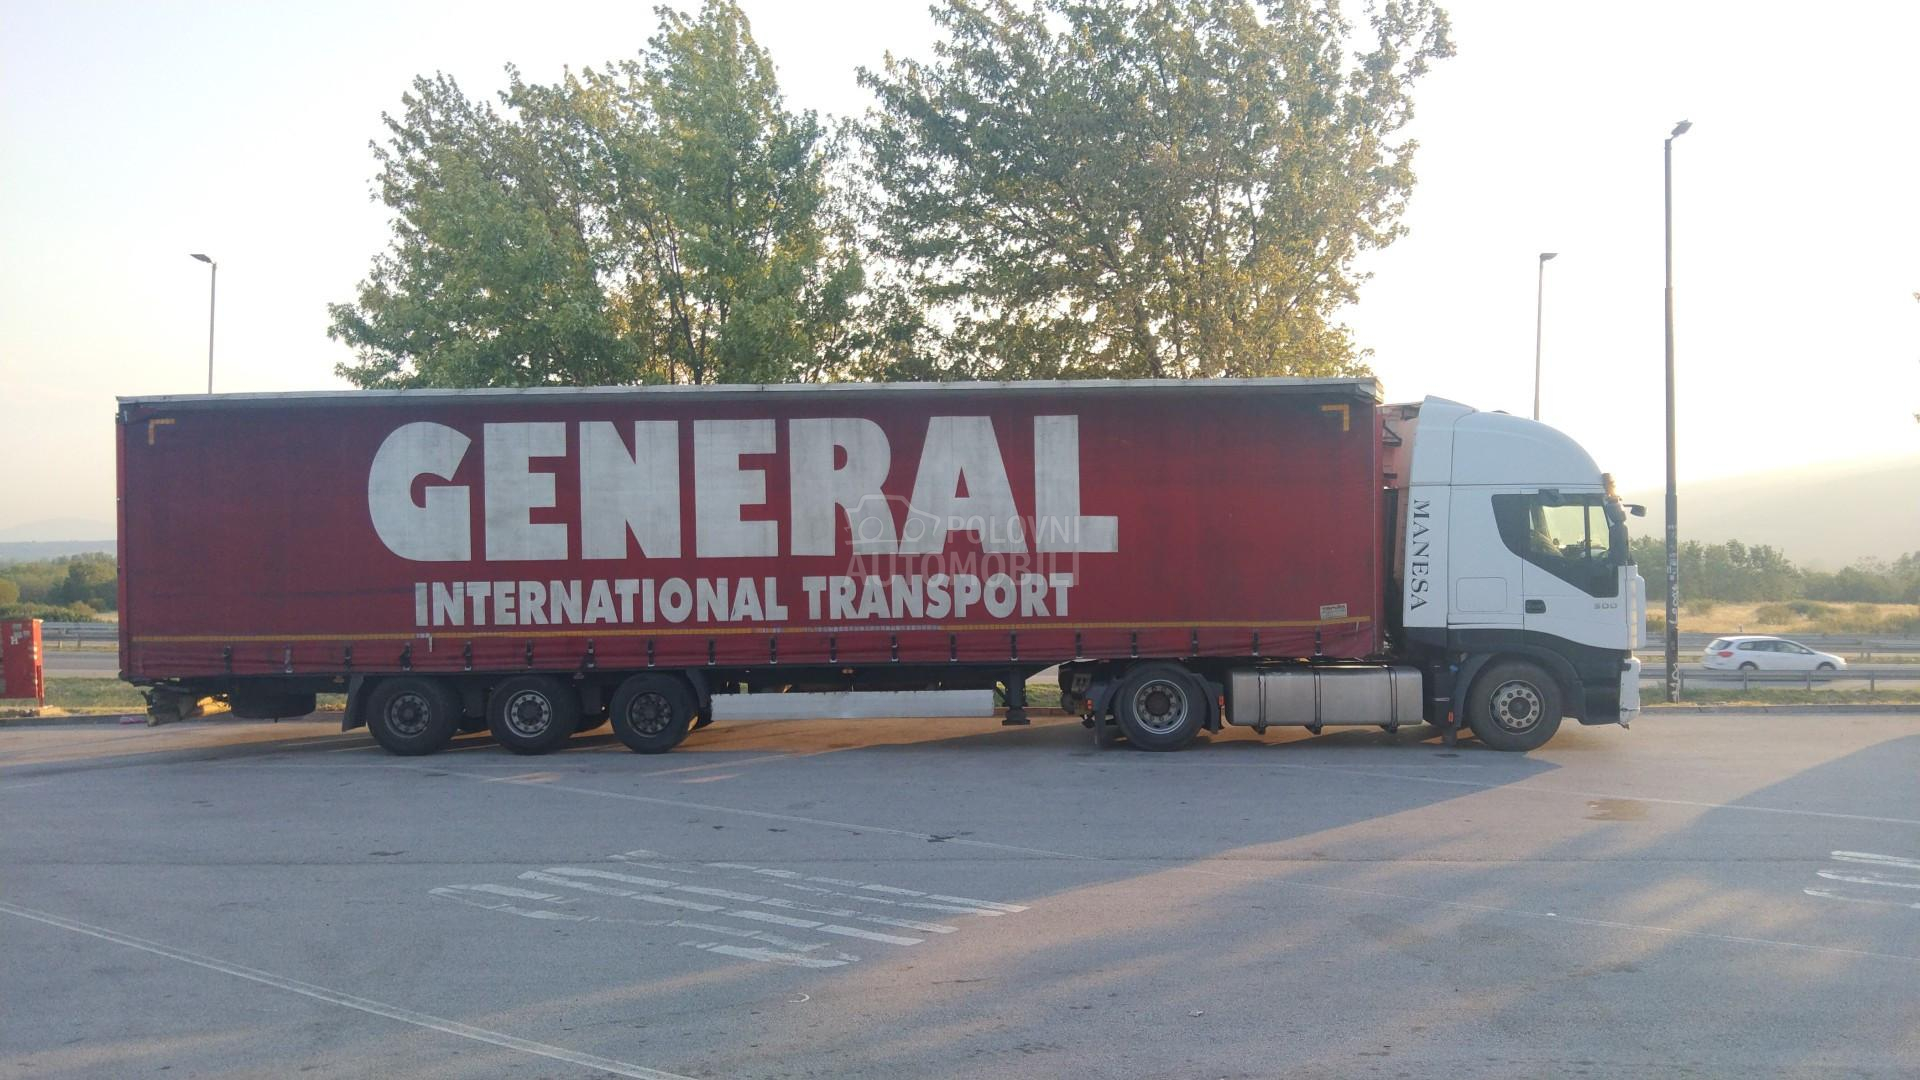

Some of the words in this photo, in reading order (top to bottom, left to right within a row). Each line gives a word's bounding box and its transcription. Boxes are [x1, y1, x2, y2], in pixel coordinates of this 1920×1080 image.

[368, 415, 1119, 561] GENERAL
[415, 577, 788, 626] INTERNATIONAL
[802, 572, 1074, 619] TRANSPORT
[1410, 499, 1430, 611] MANESA
